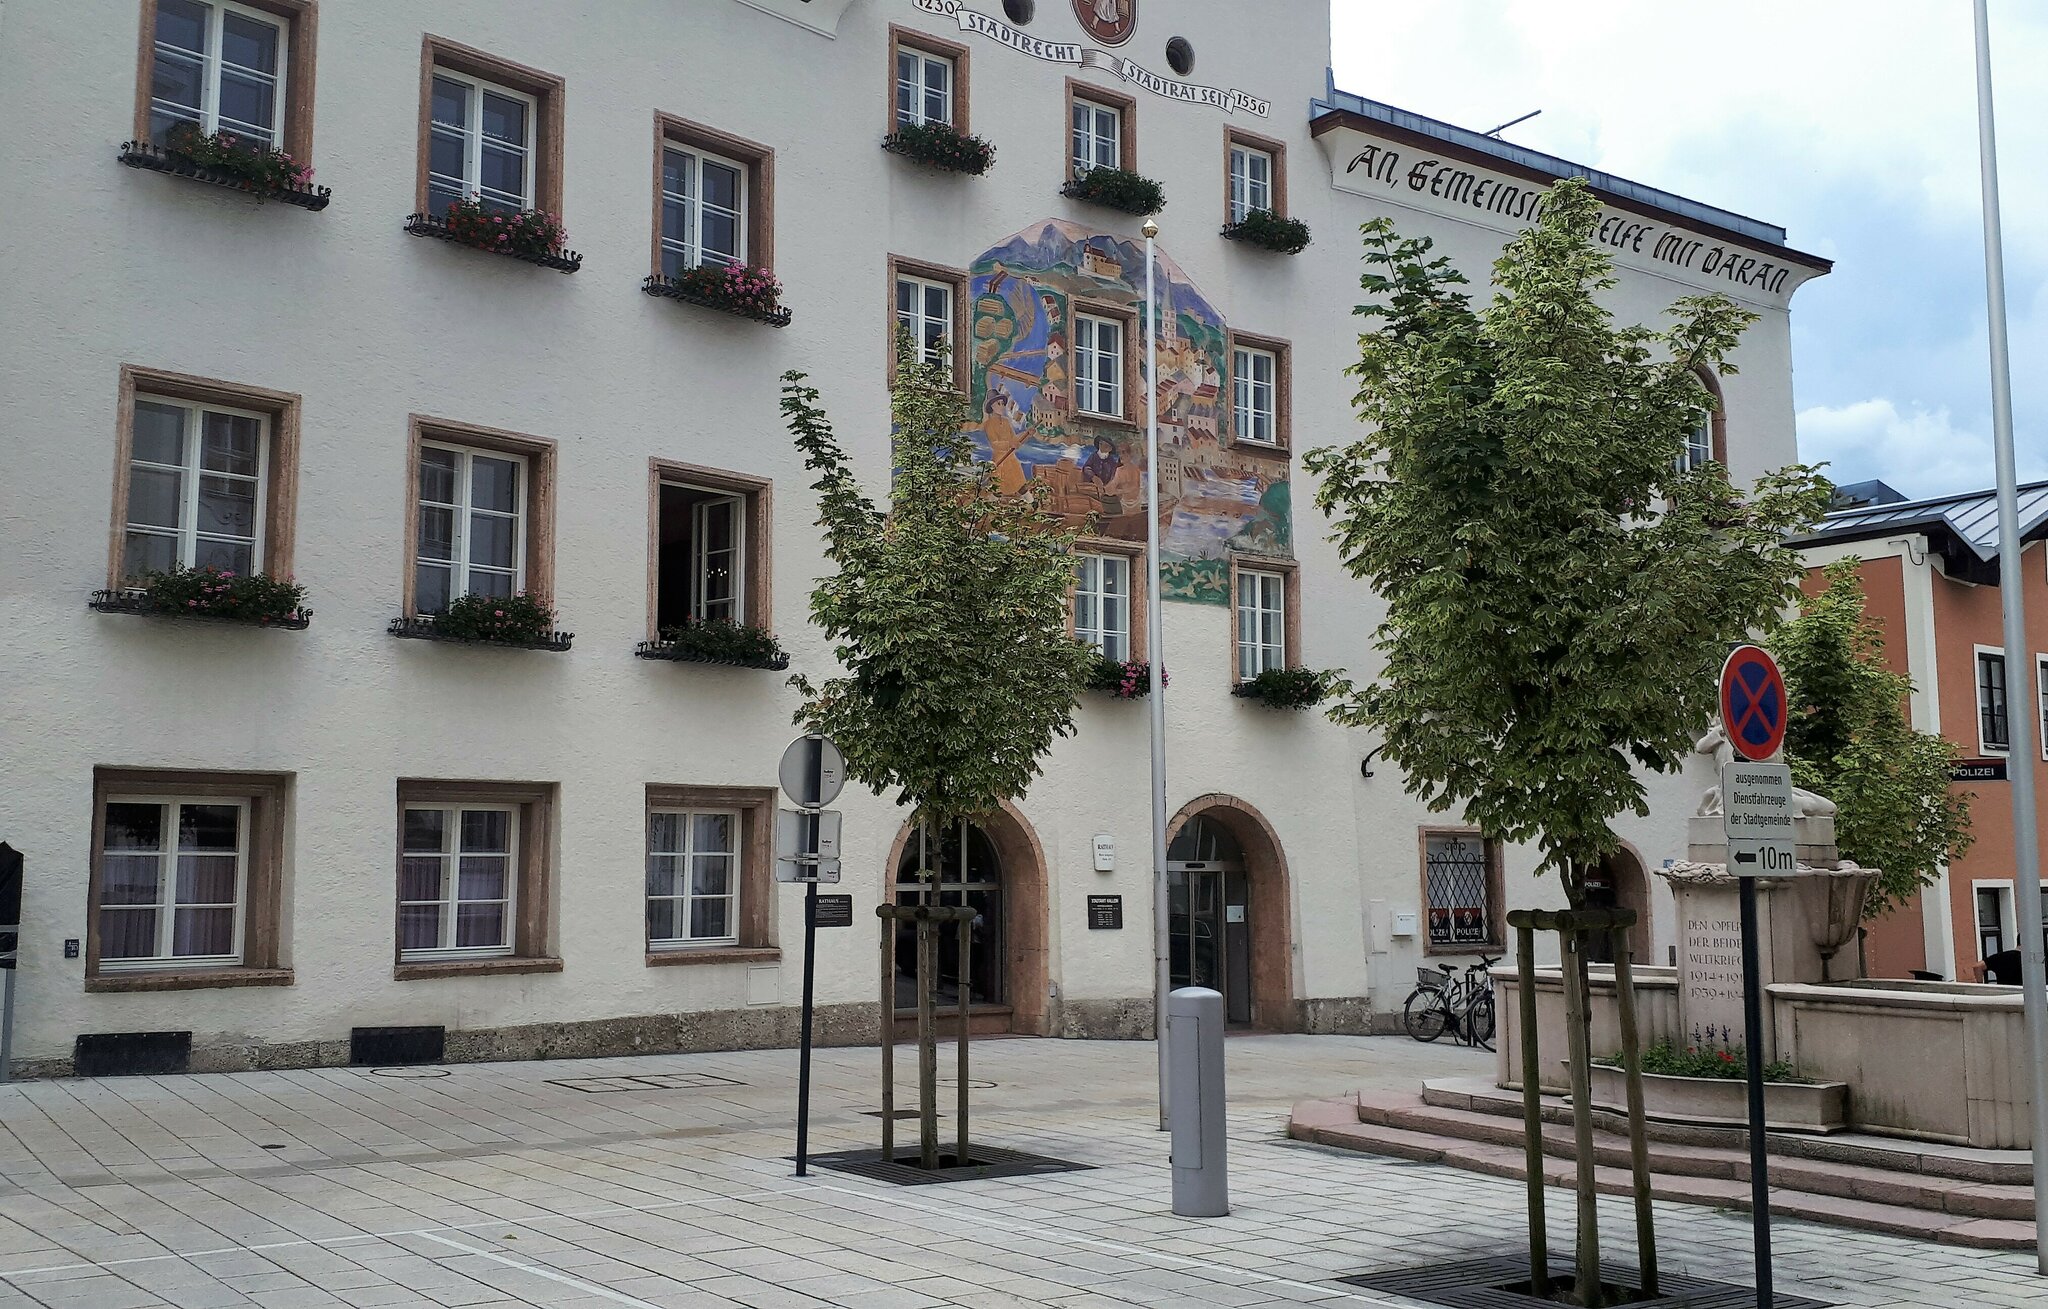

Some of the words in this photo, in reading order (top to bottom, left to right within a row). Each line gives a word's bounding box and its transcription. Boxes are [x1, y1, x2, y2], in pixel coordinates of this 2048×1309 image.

[968, 13, 1076, 61] STADTRECHT
[1127, 64, 1196, 101] STADTRAT
[1201, 86, 1230, 108] SEIT
[1236, 94, 1266, 115] 1556
[1652, 231, 1704, 268] MIT
[1702, 246, 1790, 294] DARAN
[1735, 773, 1782, 786] ausgenommen
[1953, 767, 1995, 777] POLIZEI
[1733, 792, 1786, 808] Dienstfahrzeuge
[1731, 812, 1742, 824] der
[1743, 813, 1791, 828] Stadtgemeinde
[1688, 920, 1708, 930] DEN
[1689, 937, 1709, 947] DER
[1713, 938, 1743, 949] BEIDE
